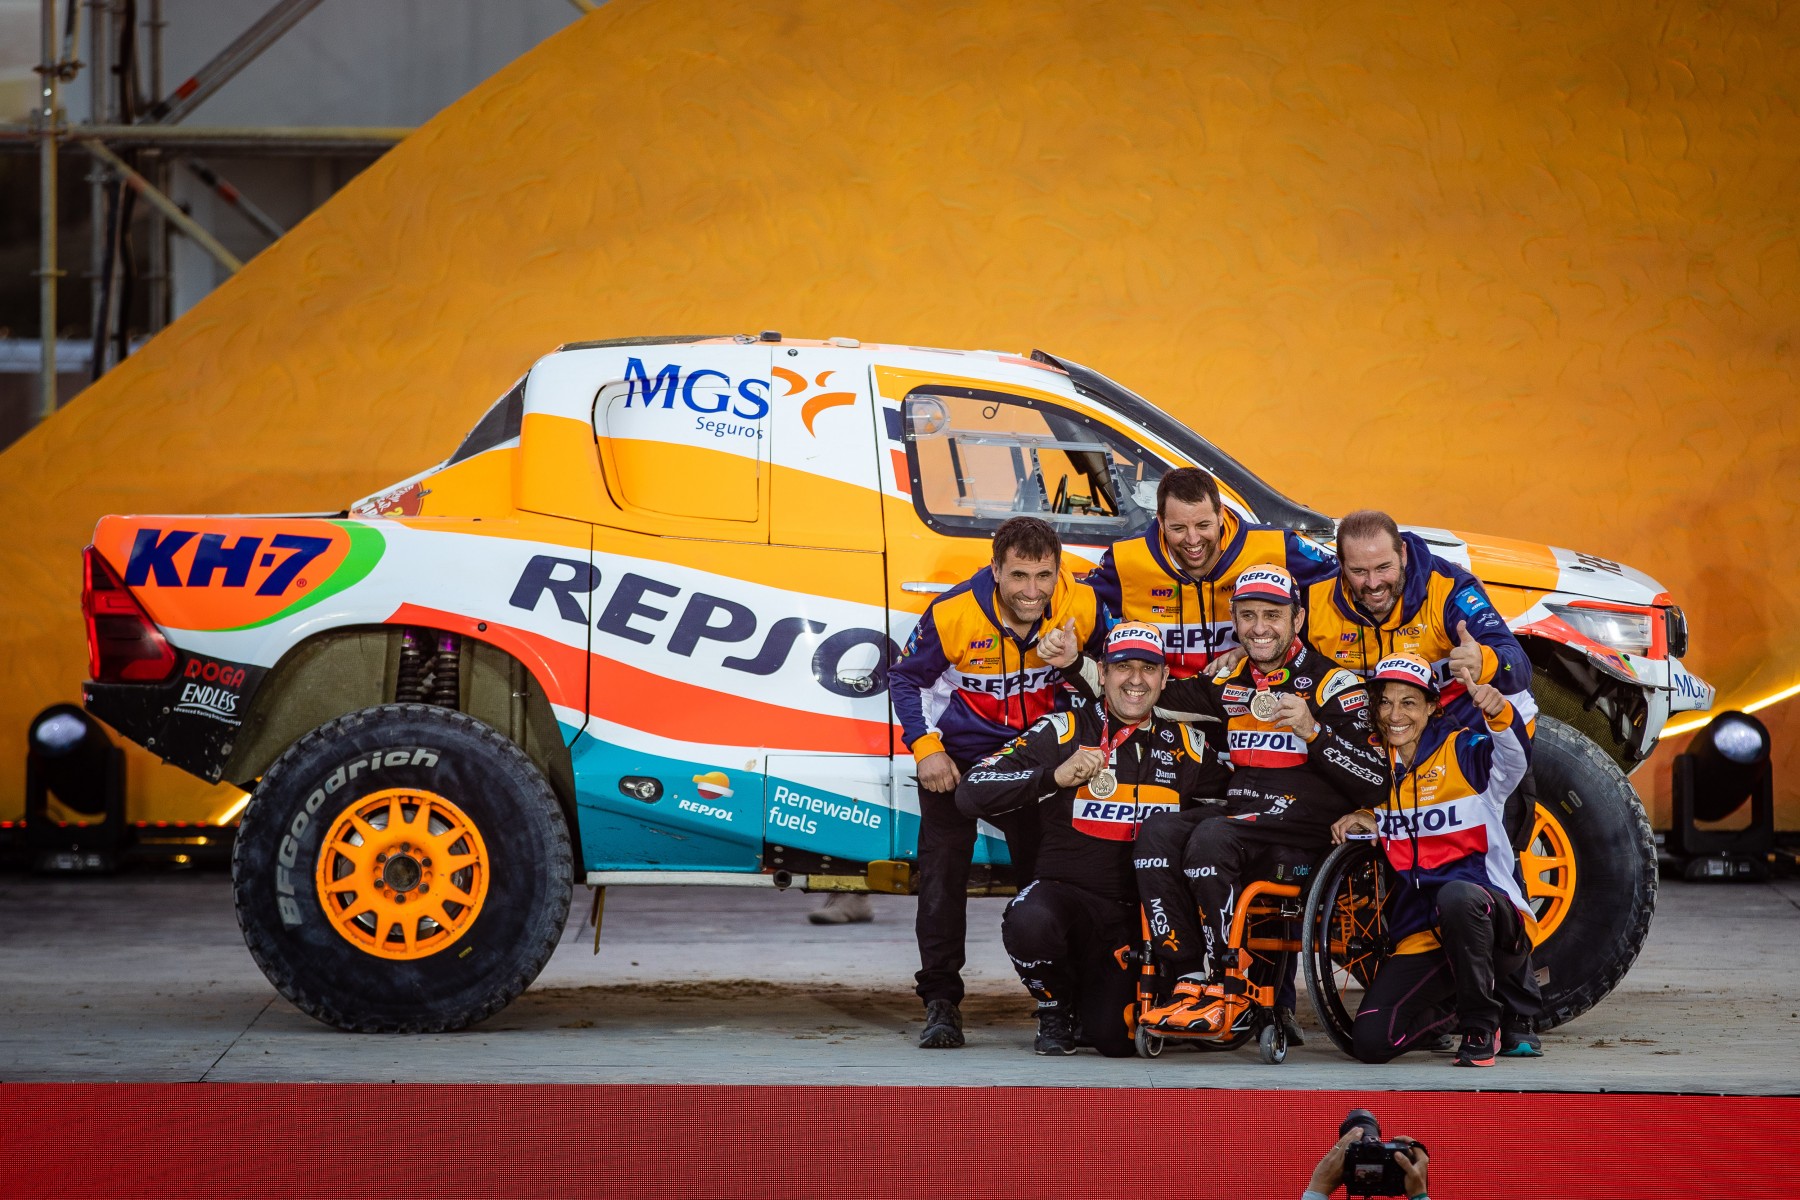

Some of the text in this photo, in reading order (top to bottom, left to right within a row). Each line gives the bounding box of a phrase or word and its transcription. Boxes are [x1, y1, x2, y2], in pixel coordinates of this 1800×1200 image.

[624, 357, 770, 420] MGS
[695, 416, 764, 440] Seguros
[1239, 572, 1286, 586] REPSOL
[508, 554, 902, 699] REPSO
[1113, 629, 1159, 643] REPSOL
[1396, 627, 1420, 637] MGS
[183, 658, 246, 688] DOGA
[1379, 659, 1426, 677] REPSOL
[961, 670, 1063, 696] REPSO
[180, 683, 240, 713] ENDLESS
[1230, 732, 1297, 751] REPSOL
[1150, 748, 1174, 762] MGS
[1155, 768, 1177, 779] Damm
[678, 799, 733, 822] REPSOL
[773, 785, 882, 829] Renewable
[768, 806, 817, 835] fuels
[276, 748, 442, 927] BFGoodrich
[1150, 898, 1170, 935] MGS
